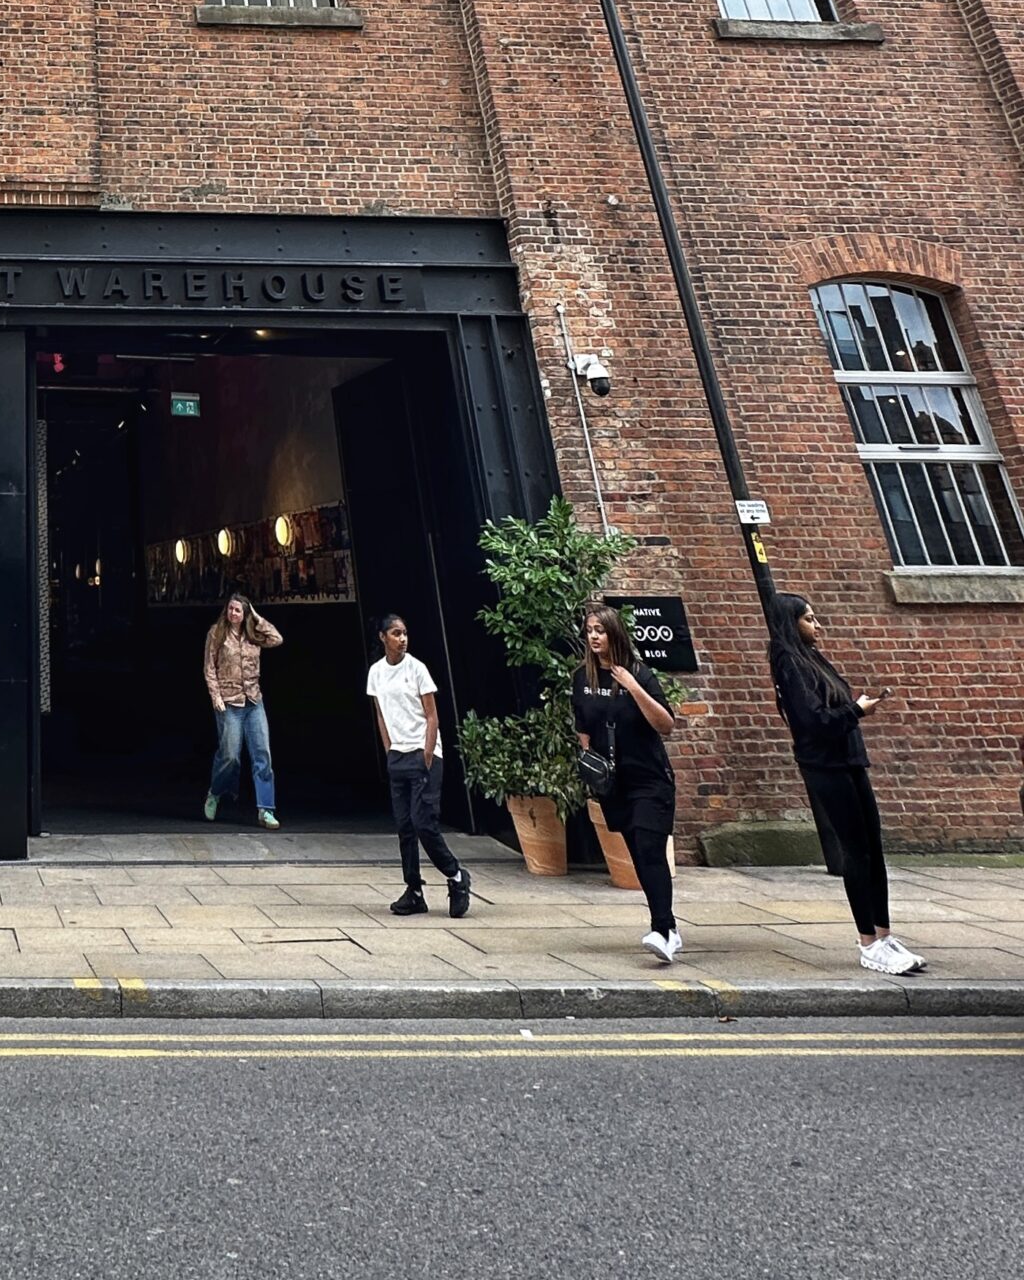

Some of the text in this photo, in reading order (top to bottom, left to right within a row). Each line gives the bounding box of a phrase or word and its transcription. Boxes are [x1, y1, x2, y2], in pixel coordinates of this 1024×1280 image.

[57, 267, 405, 303] WAREHOUSE
[633, 608, 662, 617] NATIVE
[644, 649, 668, 658] BLOK
